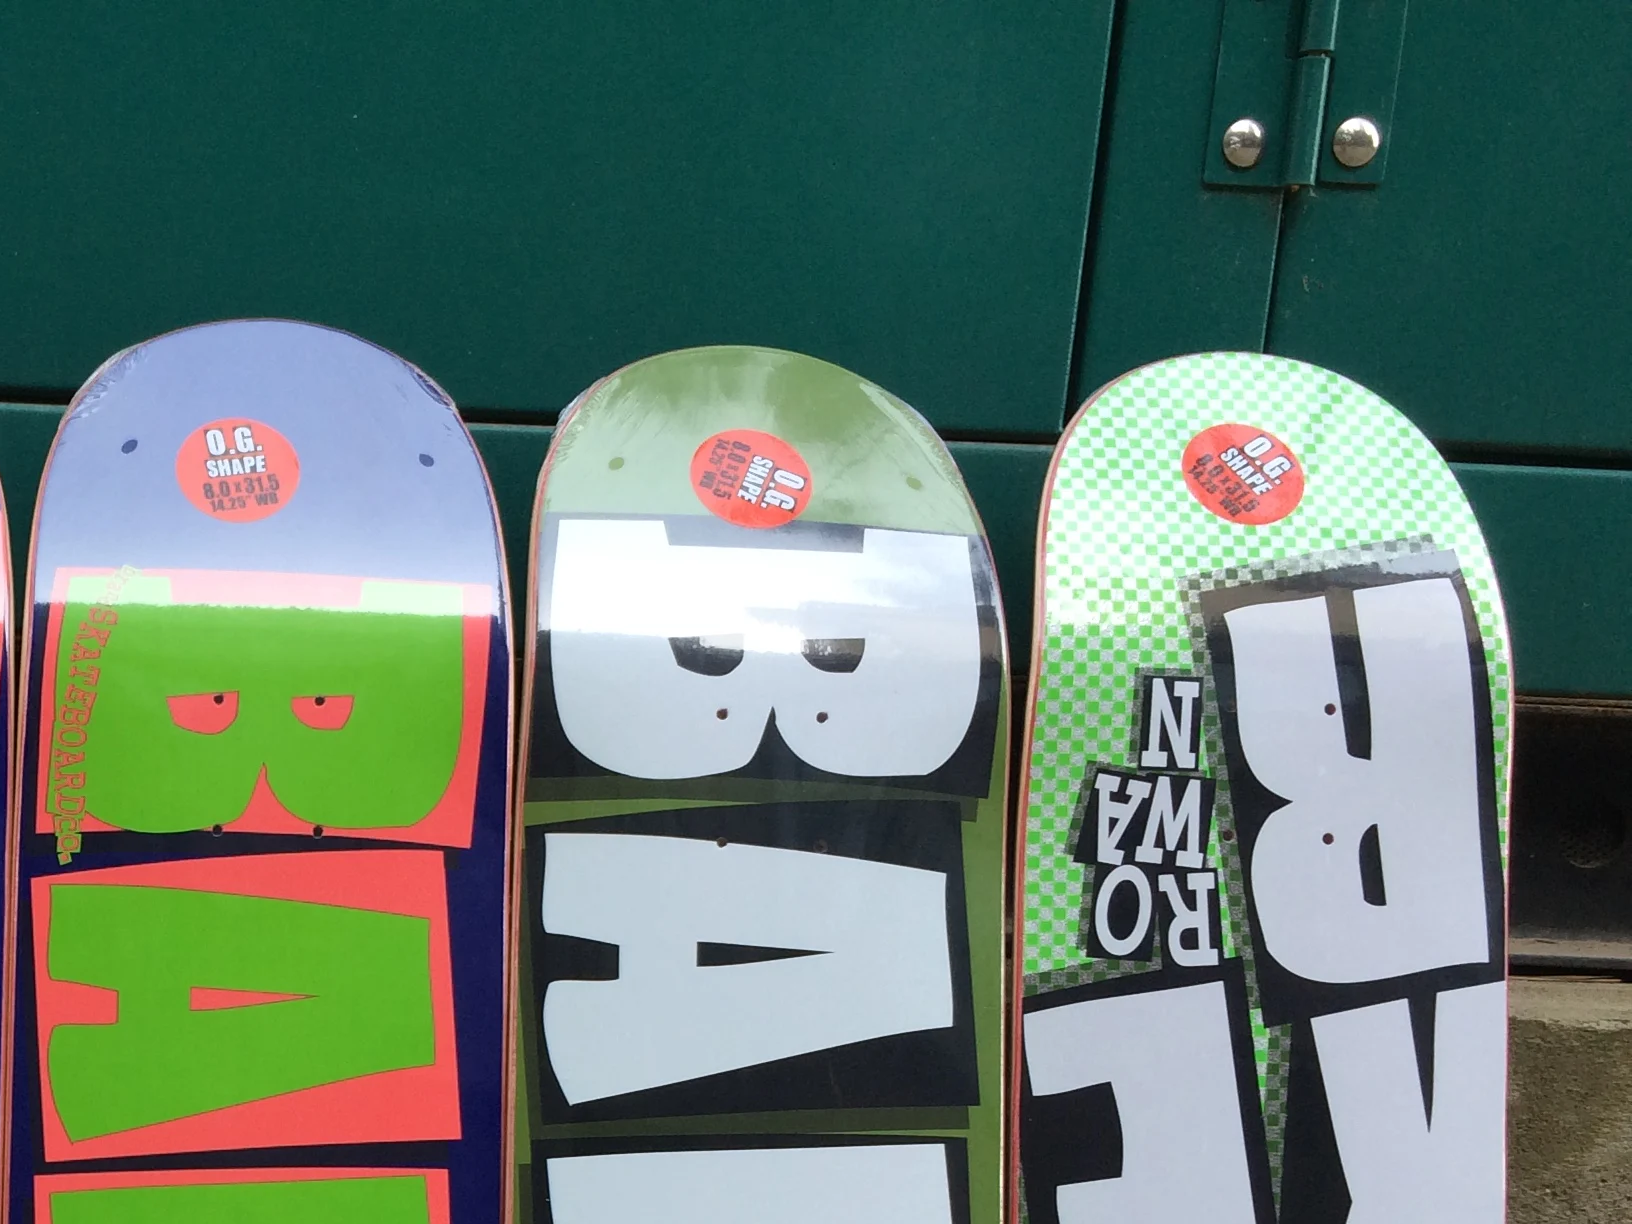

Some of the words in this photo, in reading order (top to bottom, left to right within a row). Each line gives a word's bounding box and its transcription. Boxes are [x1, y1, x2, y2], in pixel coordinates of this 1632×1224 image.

[205, 455, 267, 478] SHAPE
[737, 455, 774, 504] SHAPE
[1219, 447, 1274, 496] SHAPE
[202, 481, 230, 499] 8.0
[243, 474, 280, 494] 31.5
